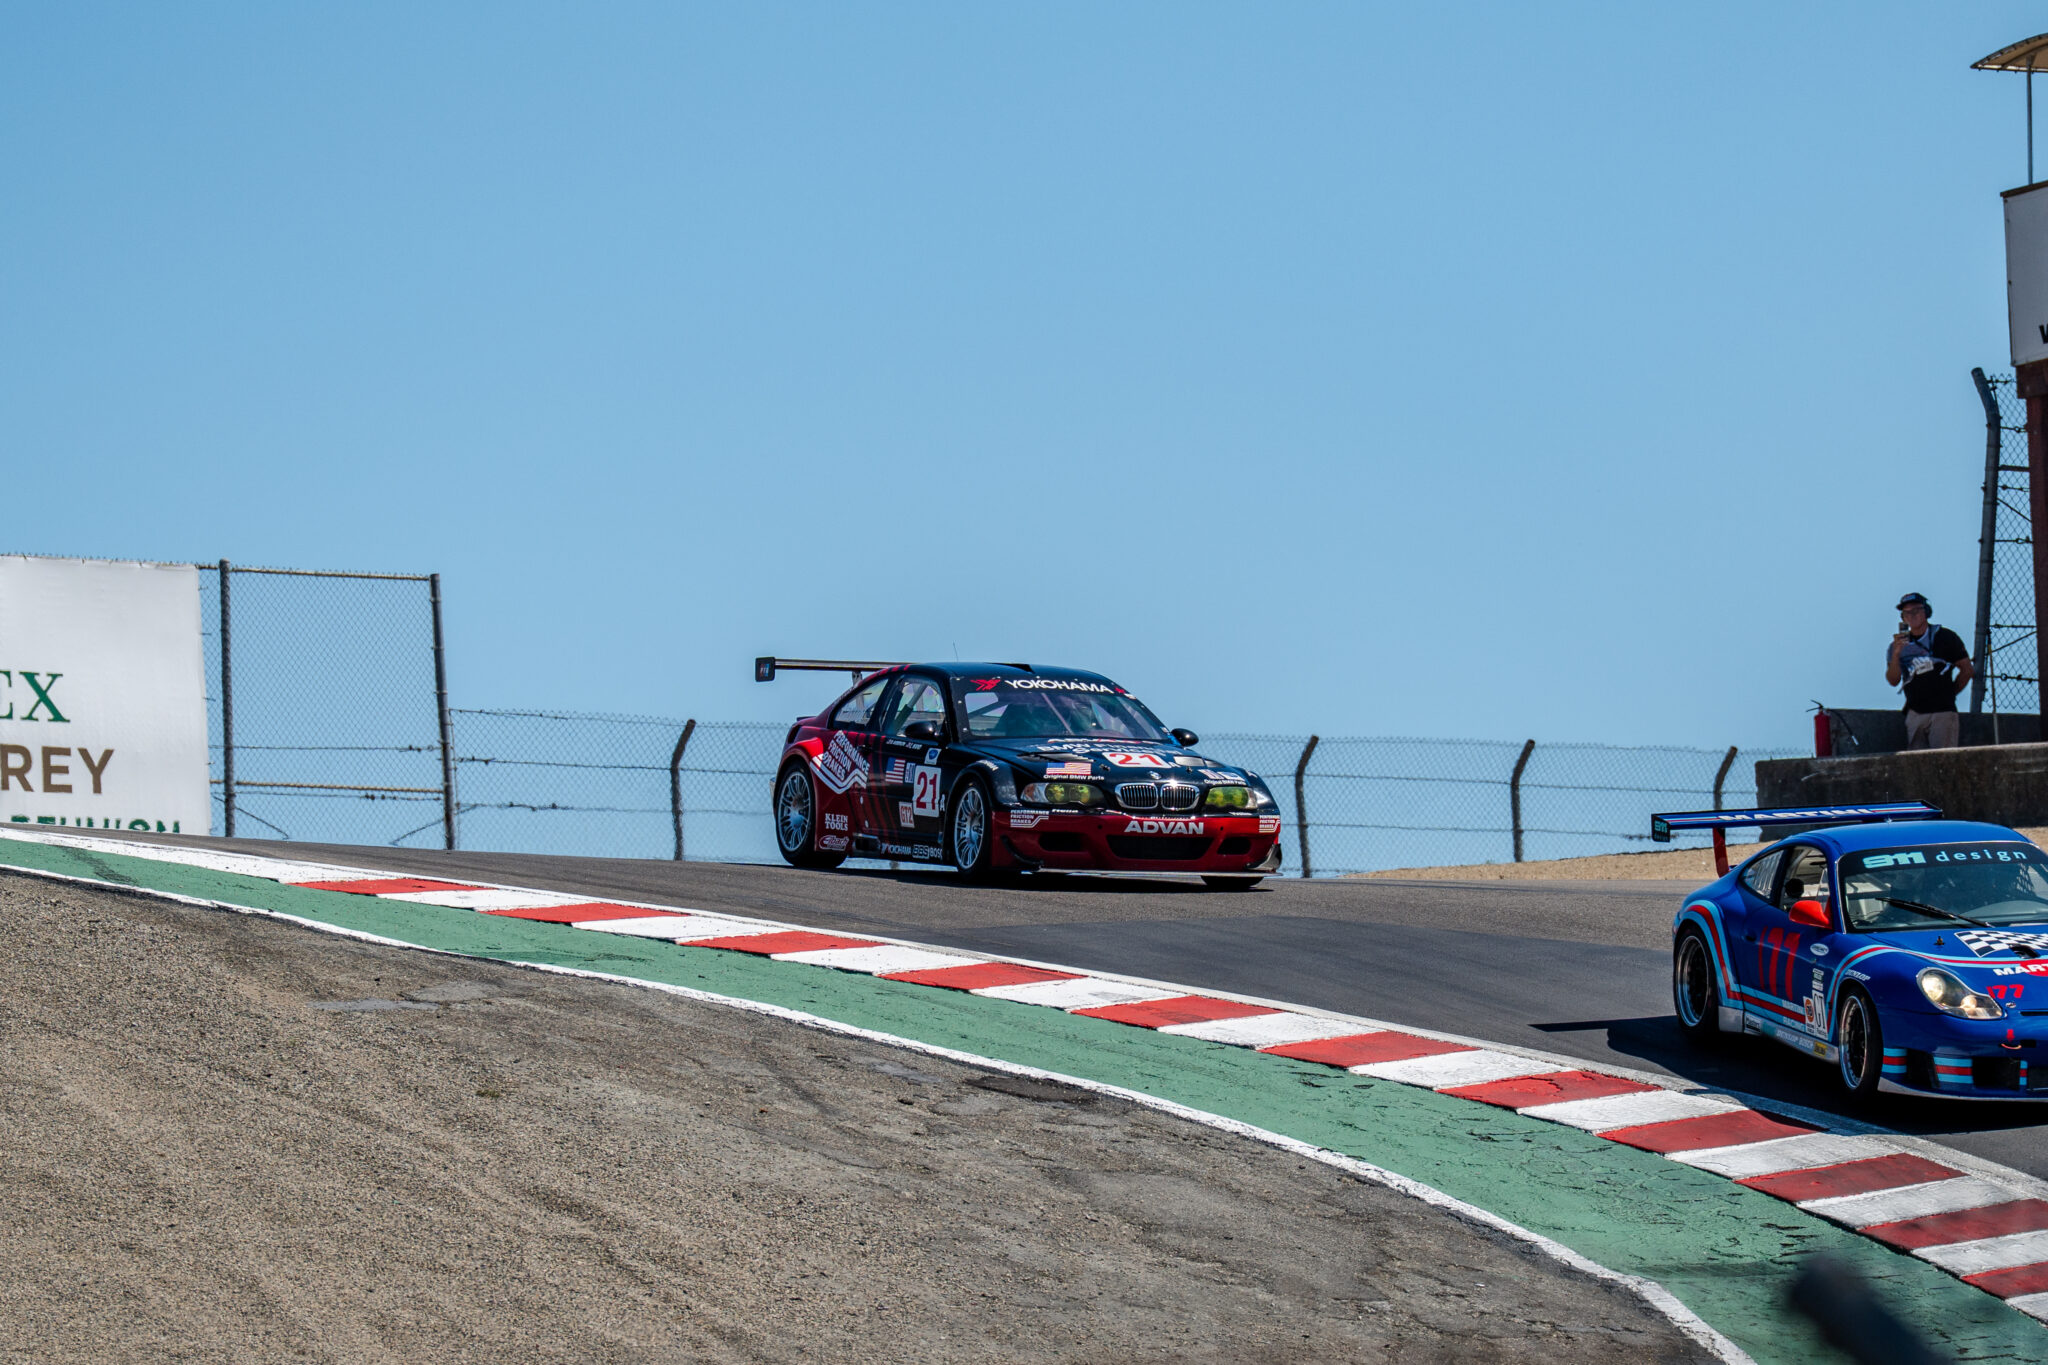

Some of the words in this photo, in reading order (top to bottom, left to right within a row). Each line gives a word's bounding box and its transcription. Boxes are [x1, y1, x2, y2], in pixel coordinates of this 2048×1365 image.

[1004, 679, 1115, 694] YOKOHAMA
[828, 739, 852, 772] FRICTION
[833, 729, 870, 776] PERFORMANCE
[1109, 752, 1164, 766] 21
[0, 743, 115, 794] REY
[821, 750, 846, 781] BRAKES
[916, 771, 938, 811] 21
[825, 813, 848, 823] KLEIN
[900, 806, 914, 824] GT2
[1718, 807, 1874, 821] MARTINI
[825, 821, 849, 832] TOOLS
[1124, 820, 1205, 835] ADVAN
[1936, 849, 2028, 863] design
